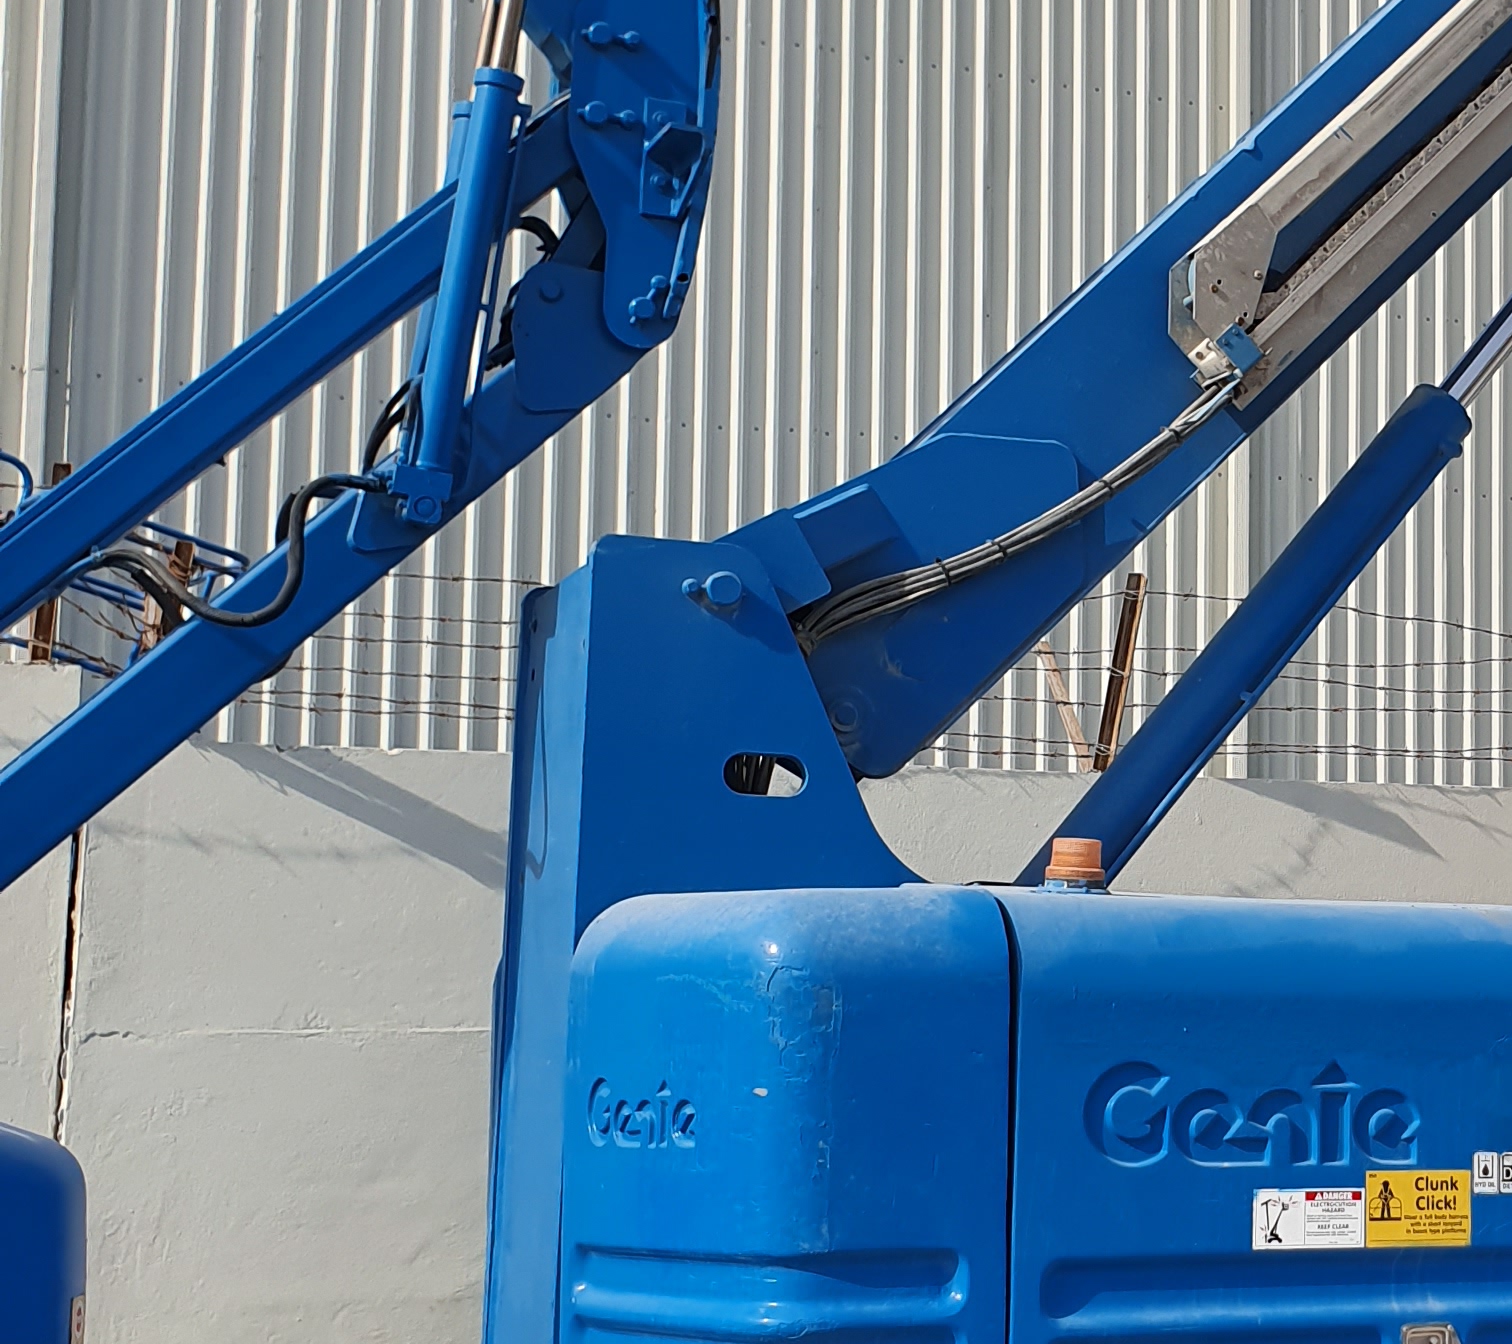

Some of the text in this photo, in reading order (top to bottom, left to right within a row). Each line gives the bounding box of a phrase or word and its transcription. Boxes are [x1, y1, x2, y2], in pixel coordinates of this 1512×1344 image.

[587, 1076, 697, 1150] Genie
[1082, 1059, 1421, 1168] Genie
[1414, 1176, 1459, 1192] Clunk
[1322, 1192, 1353, 1201] DANGER
[1415, 1194, 1458, 1211] Click!
